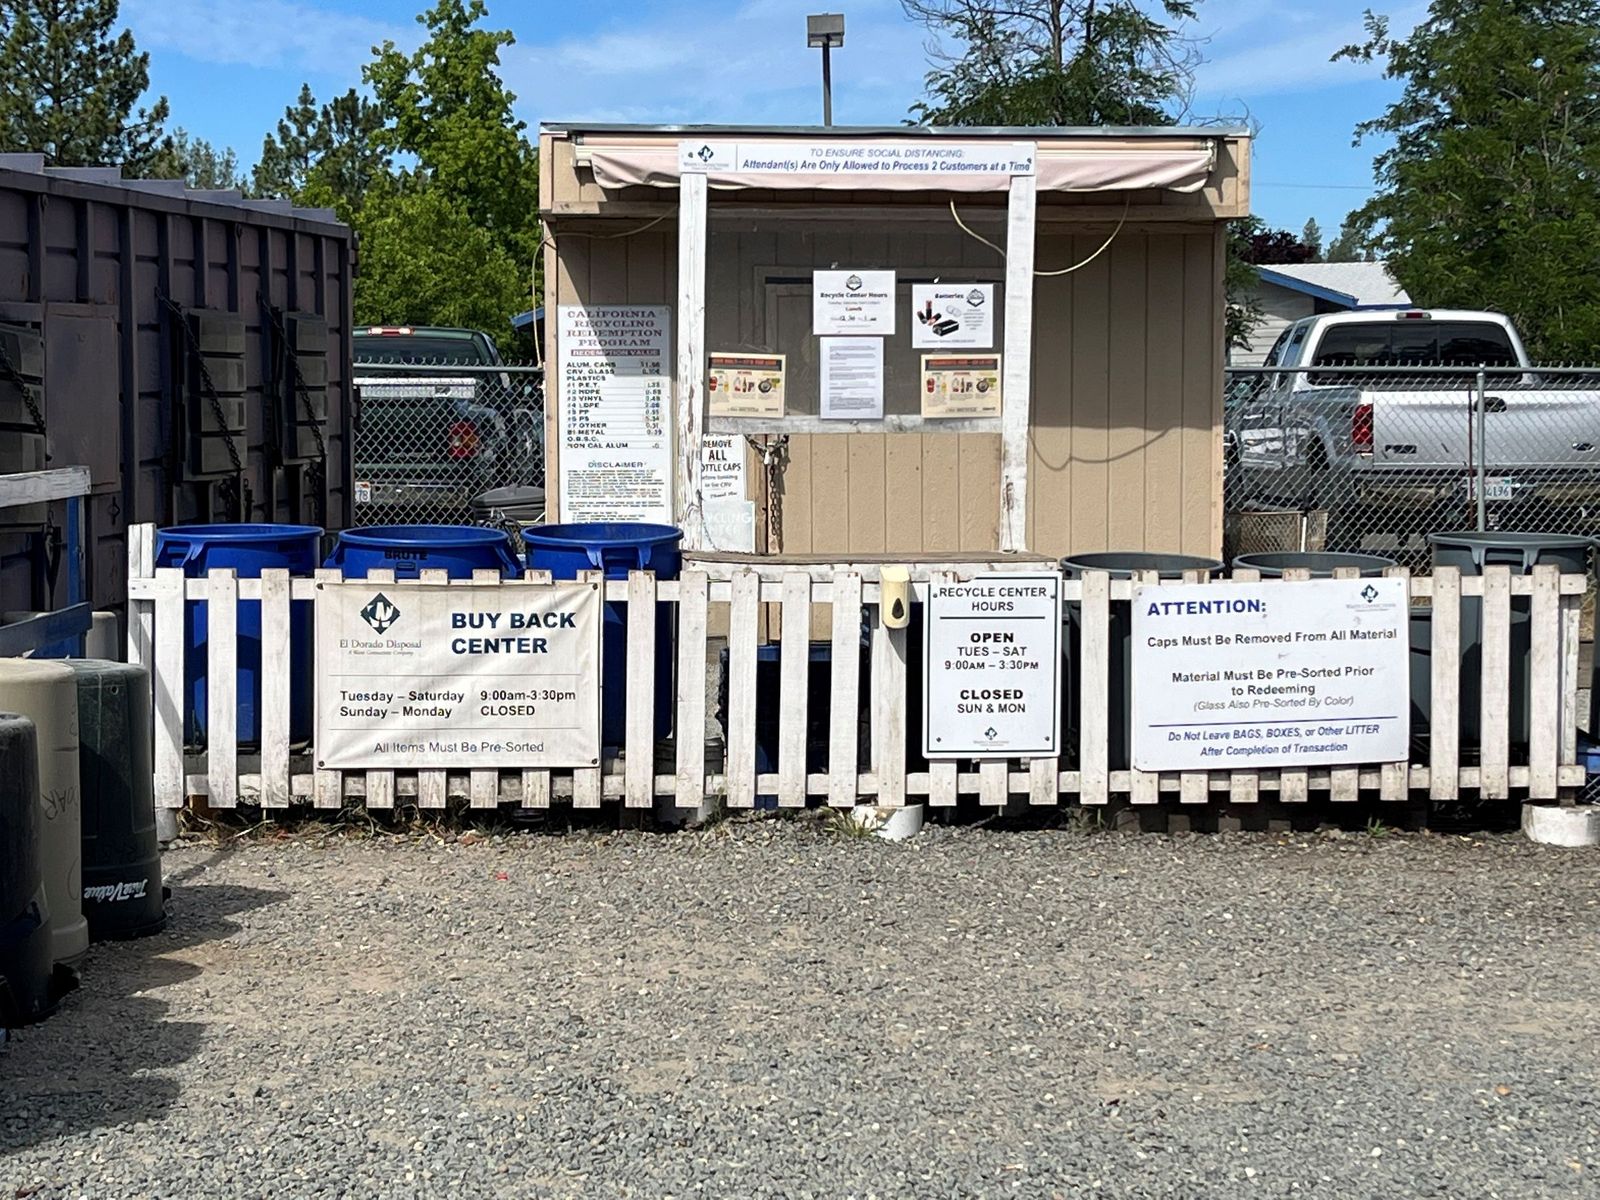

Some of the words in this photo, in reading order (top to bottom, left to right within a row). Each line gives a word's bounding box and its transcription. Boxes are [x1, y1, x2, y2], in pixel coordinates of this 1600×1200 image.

[810, 149, 823, 157] TO
[825, 149, 865, 158] ENSURE
[867, 149, 901, 158] SOCIAL
[743, 160, 798, 172] Attendant(s)
[801, 161, 817, 171] Are
[819, 161, 840, 172] Only
[842, 161, 879, 171] Allowed
[881, 162, 890, 171] to
[893, 162, 929, 171] Process
[932, 162, 938, 171] 2
[939, 162, 987, 172] Customers
[989, 163, 998, 172] at
[1009, 162, 1030, 172] Time
[567, 310, 656, 318] CALIFORNIA
[574, 320, 655, 328] RECYCLING
[567, 329, 662, 337] REDEMPTION
[578, 339, 651, 347] PROGRAM
[708, 450, 727, 461] ALL
[701, 463, 721, 472] OTTLE
[722, 463, 741, 472] CAPS
[384, 550, 428, 561] BRUTE
[939, 587, 995, 597] RECYCLE
[999, 587, 1047, 597] CENTER
[971, 601, 1014, 611] HOURS
[1147, 599, 1266, 616] ATTENTION:
[452, 612, 503, 629] BUY
[510, 612, 577, 629] BACK
[970, 633, 1014, 643] OPEN
[1147, 636, 1178, 648] Caps
[1182, 634, 1212, 646] Must
[1215, 634, 1231, 645] Be
[1235, 632, 1292, 645] Removed
[1295, 631, 1327, 642] From
[1330, 630, 1347, 641] All
[1350, 628, 1398, 641] Material
[339, 640, 349, 649] El
[351, 640, 384, 649] Dorado
[386, 640, 422, 650] Disposal
[451, 637, 548, 654] CENTER
[957, 647, 989, 656] TUES
[1003, 647, 1027, 656] SAT
[944, 661, 985, 670] 9:00AM
[999, 661, 1039, 670] 3:30PM
[1172, 671, 1220, 683] Material
[1224, 670, 1254, 681] Must
[1257, 669, 1273, 680] Be
[1277, 668, 1341, 680] Pre-Sorted
[1344, 666, 1374, 678] Prior
[960, 689, 1024, 700] CLOSED
[1231, 685, 1244, 696] to
[1248, 684, 1316, 697] Redeeming
[340, 690, 394, 704] Tuesday
[408, 690, 465, 704] Saturday
[480, 690, 576, 703] 9:00am-3:30pm
[957, 704, 982, 713] SUN
[986, 704, 994, 713] &
[998, 703, 1026, 713] MON
[1194, 701, 1226, 713] (Glass
[1228, 700, 1250, 711] Also
[1253, 698, 1306, 710] Pre-Sorted
[1308, 697, 1321, 709] By
[1324, 696, 1354, 708] Color)
[340, 706, 388, 719] Sunday
[402, 706, 452, 718] Monday
[480, 705, 535, 716] CLOSED
[1168, 731, 1181, 742] Do
[1183, 730, 1200, 741] Not
[1203, 729, 1230, 740] Leave
[1233, 728, 1264, 740] BAGS,
[1266, 727, 1302, 739] BOXES,
[1305, 729, 1315, 737] or
[1317, 726, 1343, 737] Other
[1346, 724, 1380, 735] LITTER
[374, 742, 389, 753] All
[393, 741, 425, 752] Items
[429, 741, 458, 752] Must
[461, 741, 477, 752] Be
[481, 741, 544, 752] Pre-Sorted
[1200, 746, 1224, 757] After
[1226, 745, 1279, 757] Completion
[1281, 744, 1292, 754] of
[1294, 742, 1348, 754] Transaction
[83, 879, 149, 902] TrueValue
